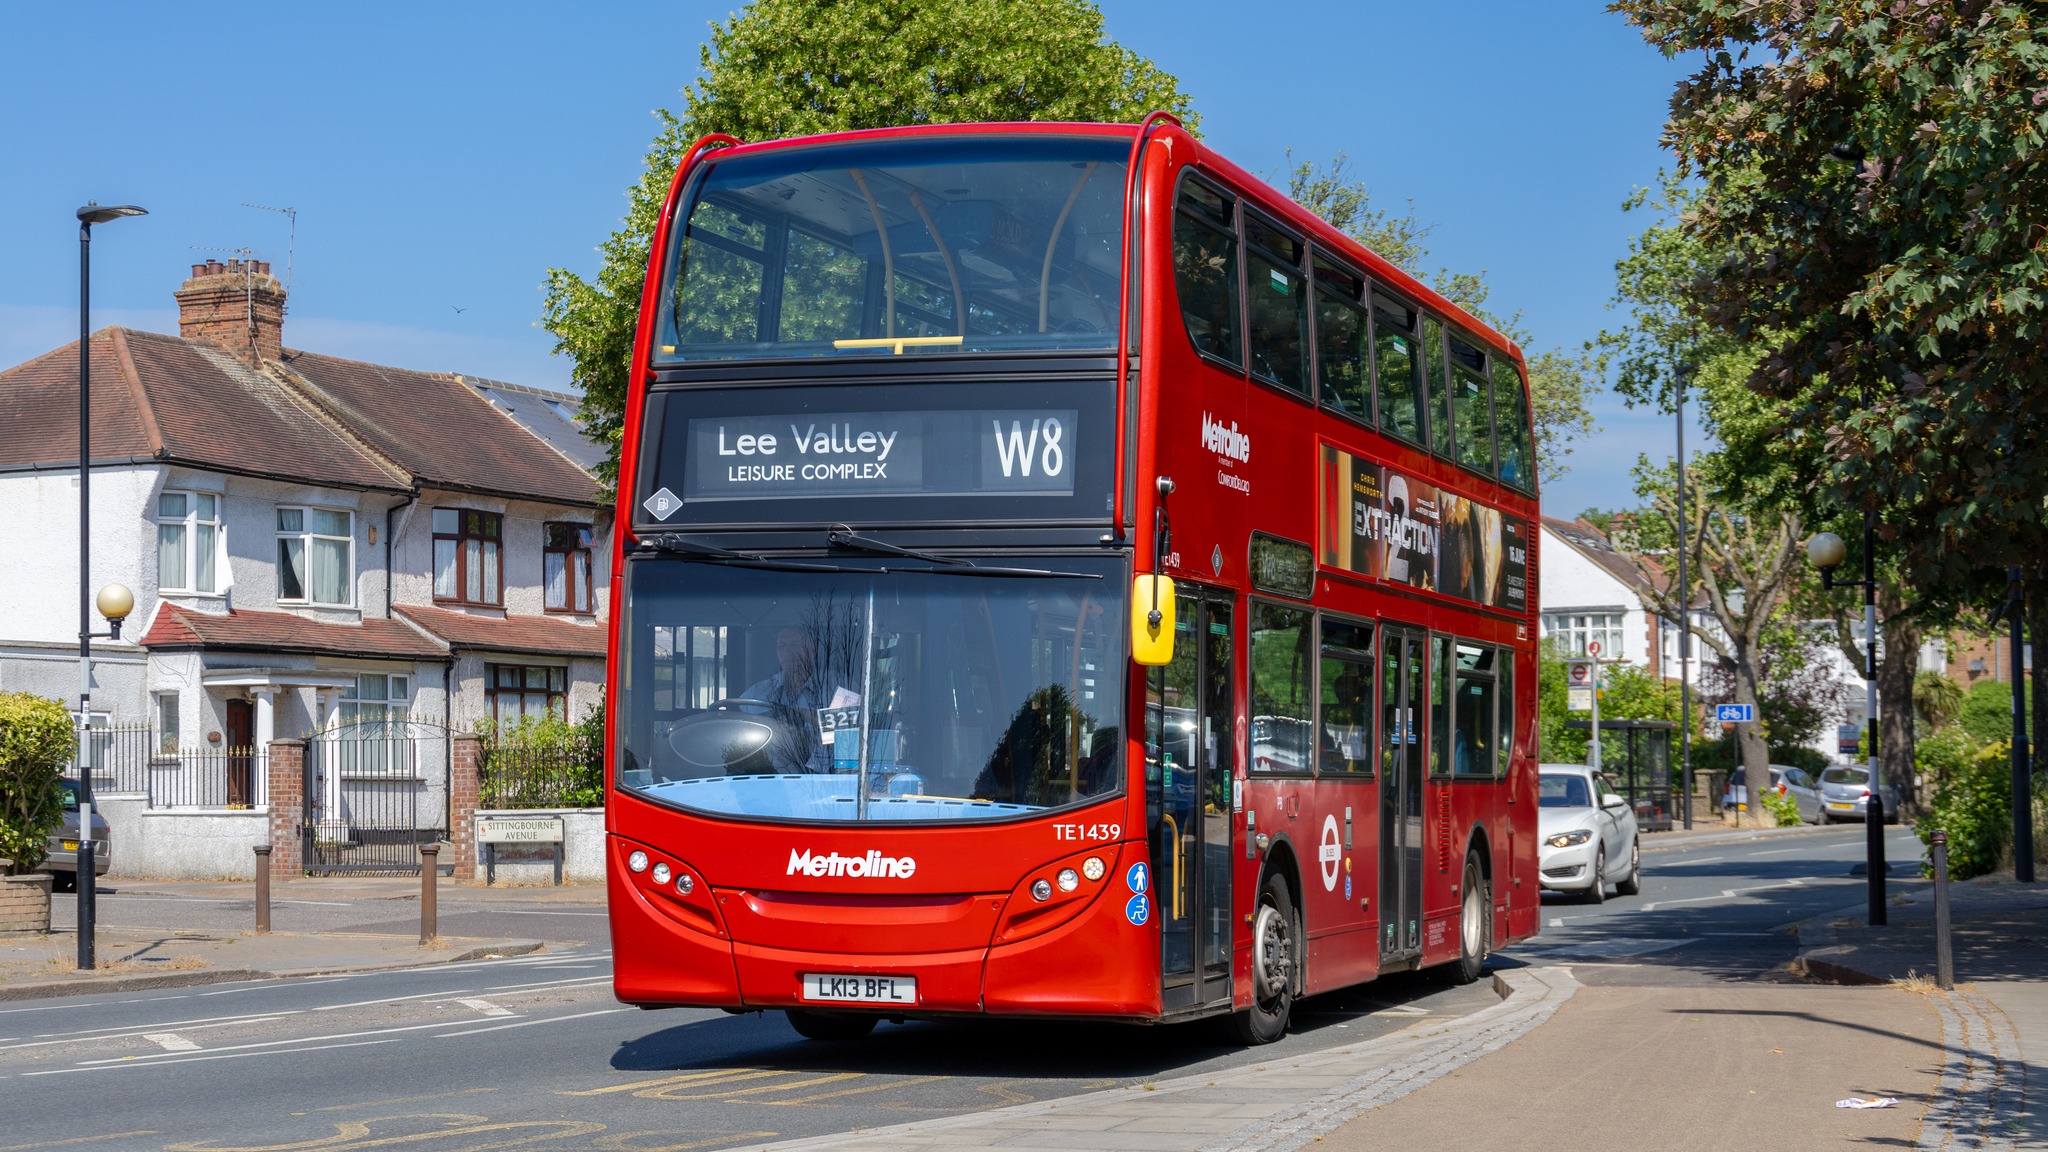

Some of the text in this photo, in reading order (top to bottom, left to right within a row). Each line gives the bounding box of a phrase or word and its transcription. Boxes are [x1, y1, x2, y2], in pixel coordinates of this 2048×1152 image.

[718, 423, 898, 461] Lee Valley
[1201, 409, 1250, 463] Metroline
[992, 417, 1064, 478] W8
[728, 463, 888, 482] LEISURE COMPLEX
[1360, 473, 1375, 486] CHRIS
[1353, 482, 1383, 499] HEMSWORTH
[1354, 501, 1440, 557] EXTRACTION
[1388, 475, 1410, 581] 2
[824, 710, 859, 729] 327
[488, 821, 554, 830] SITTINGBOURNE
[505, 831, 538, 840] AVENUE
[1053, 824, 1121, 841] TE1439
[786, 848, 916, 879] Metroline
[819, 977, 903, 1001] LK13 BFL
